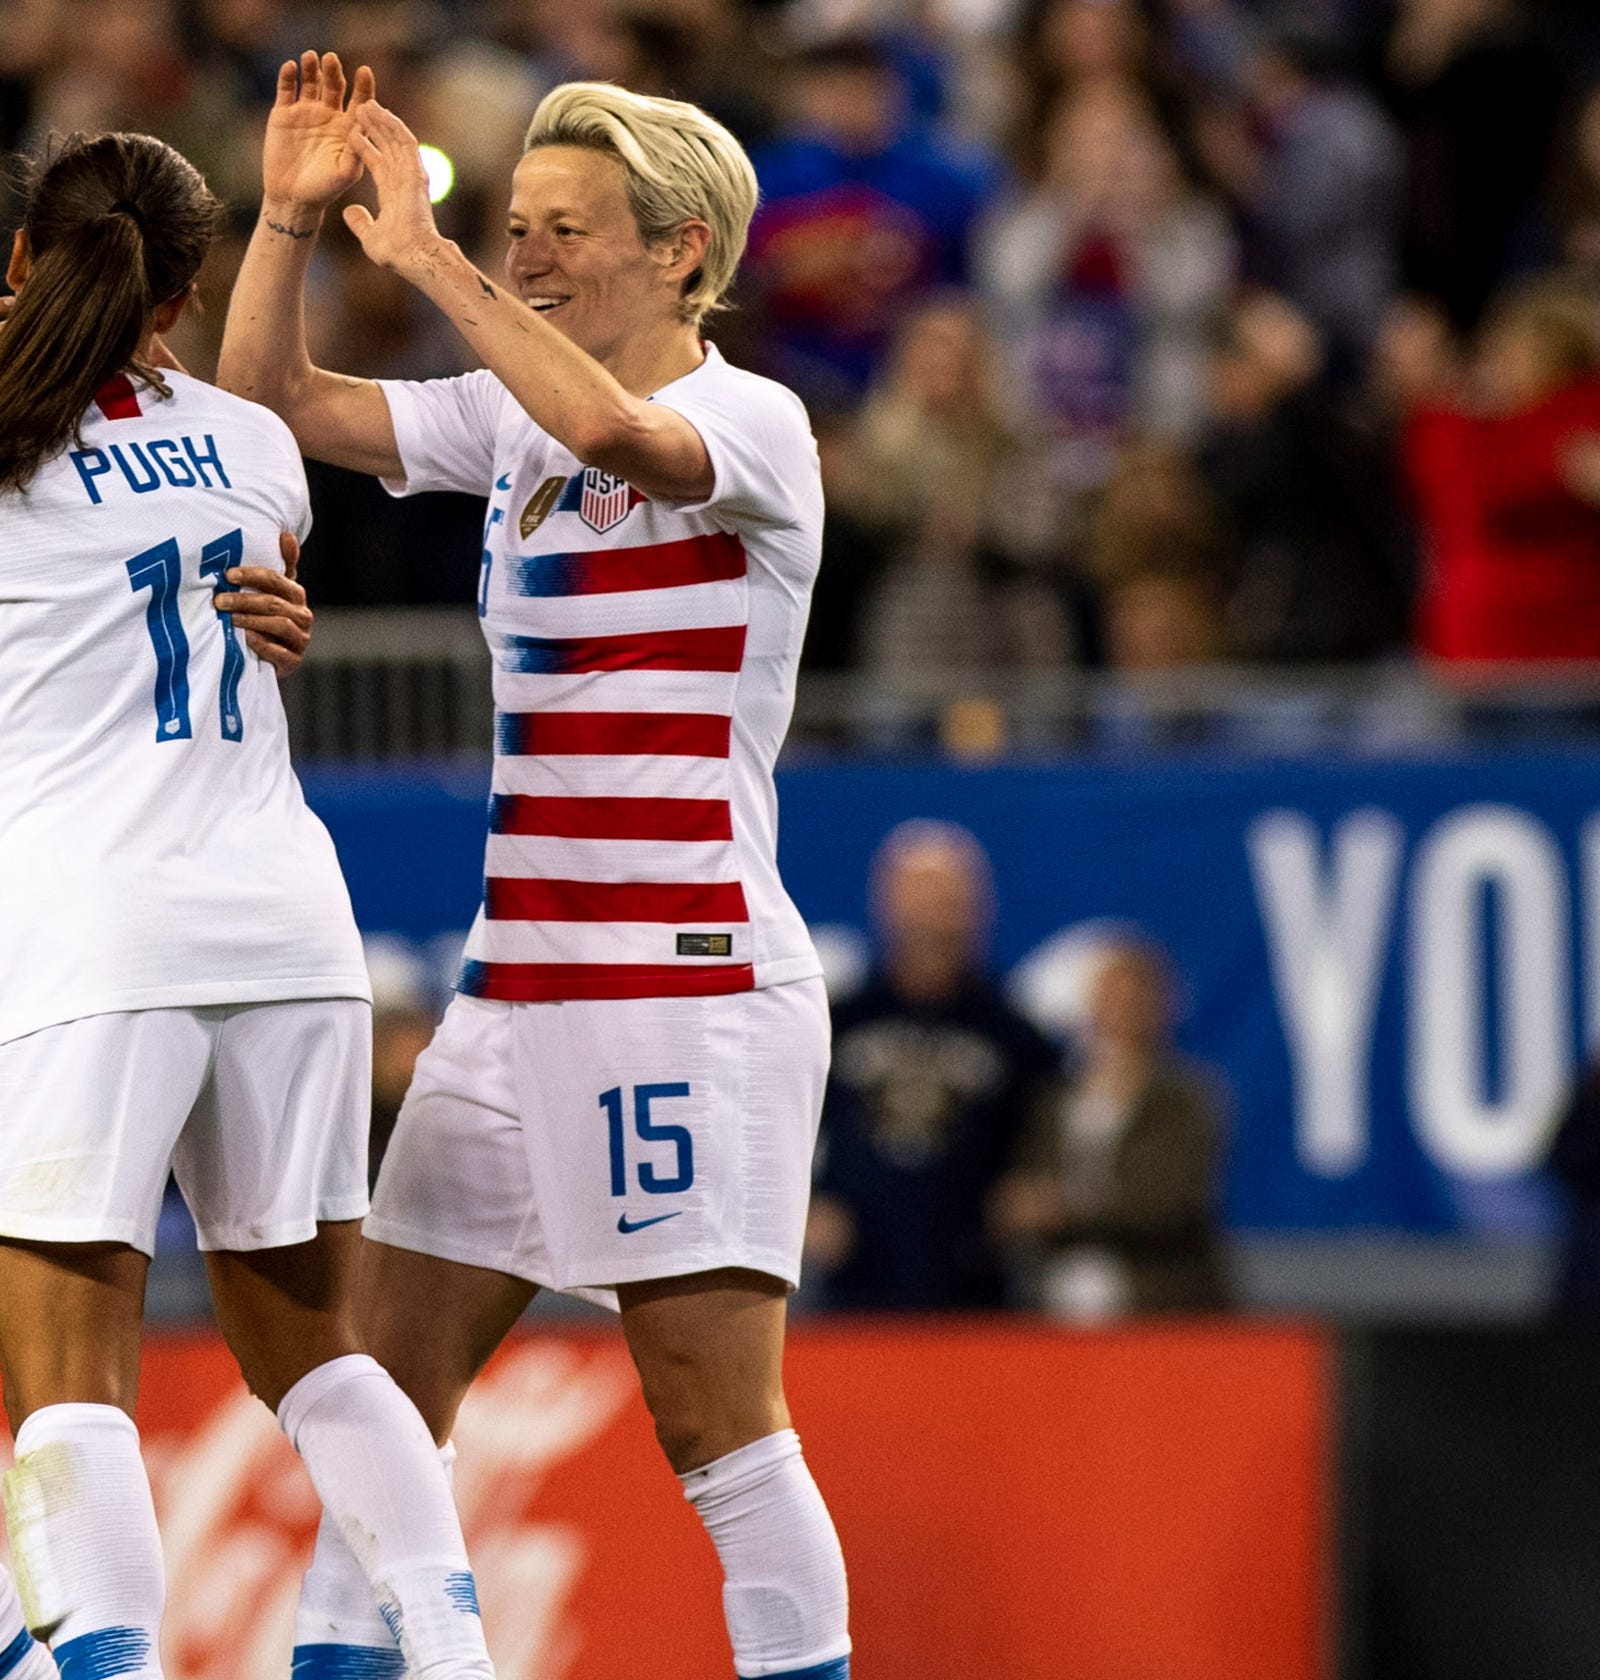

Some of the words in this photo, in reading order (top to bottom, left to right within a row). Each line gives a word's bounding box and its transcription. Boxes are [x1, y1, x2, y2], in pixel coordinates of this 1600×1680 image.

[68, 433, 233, 505] PUGH
[586, 469, 626, 495] USA
[124, 528, 245, 743] 11
[1245, 800, 1600, 1184] YO
[598, 1081, 695, 1197] 15
